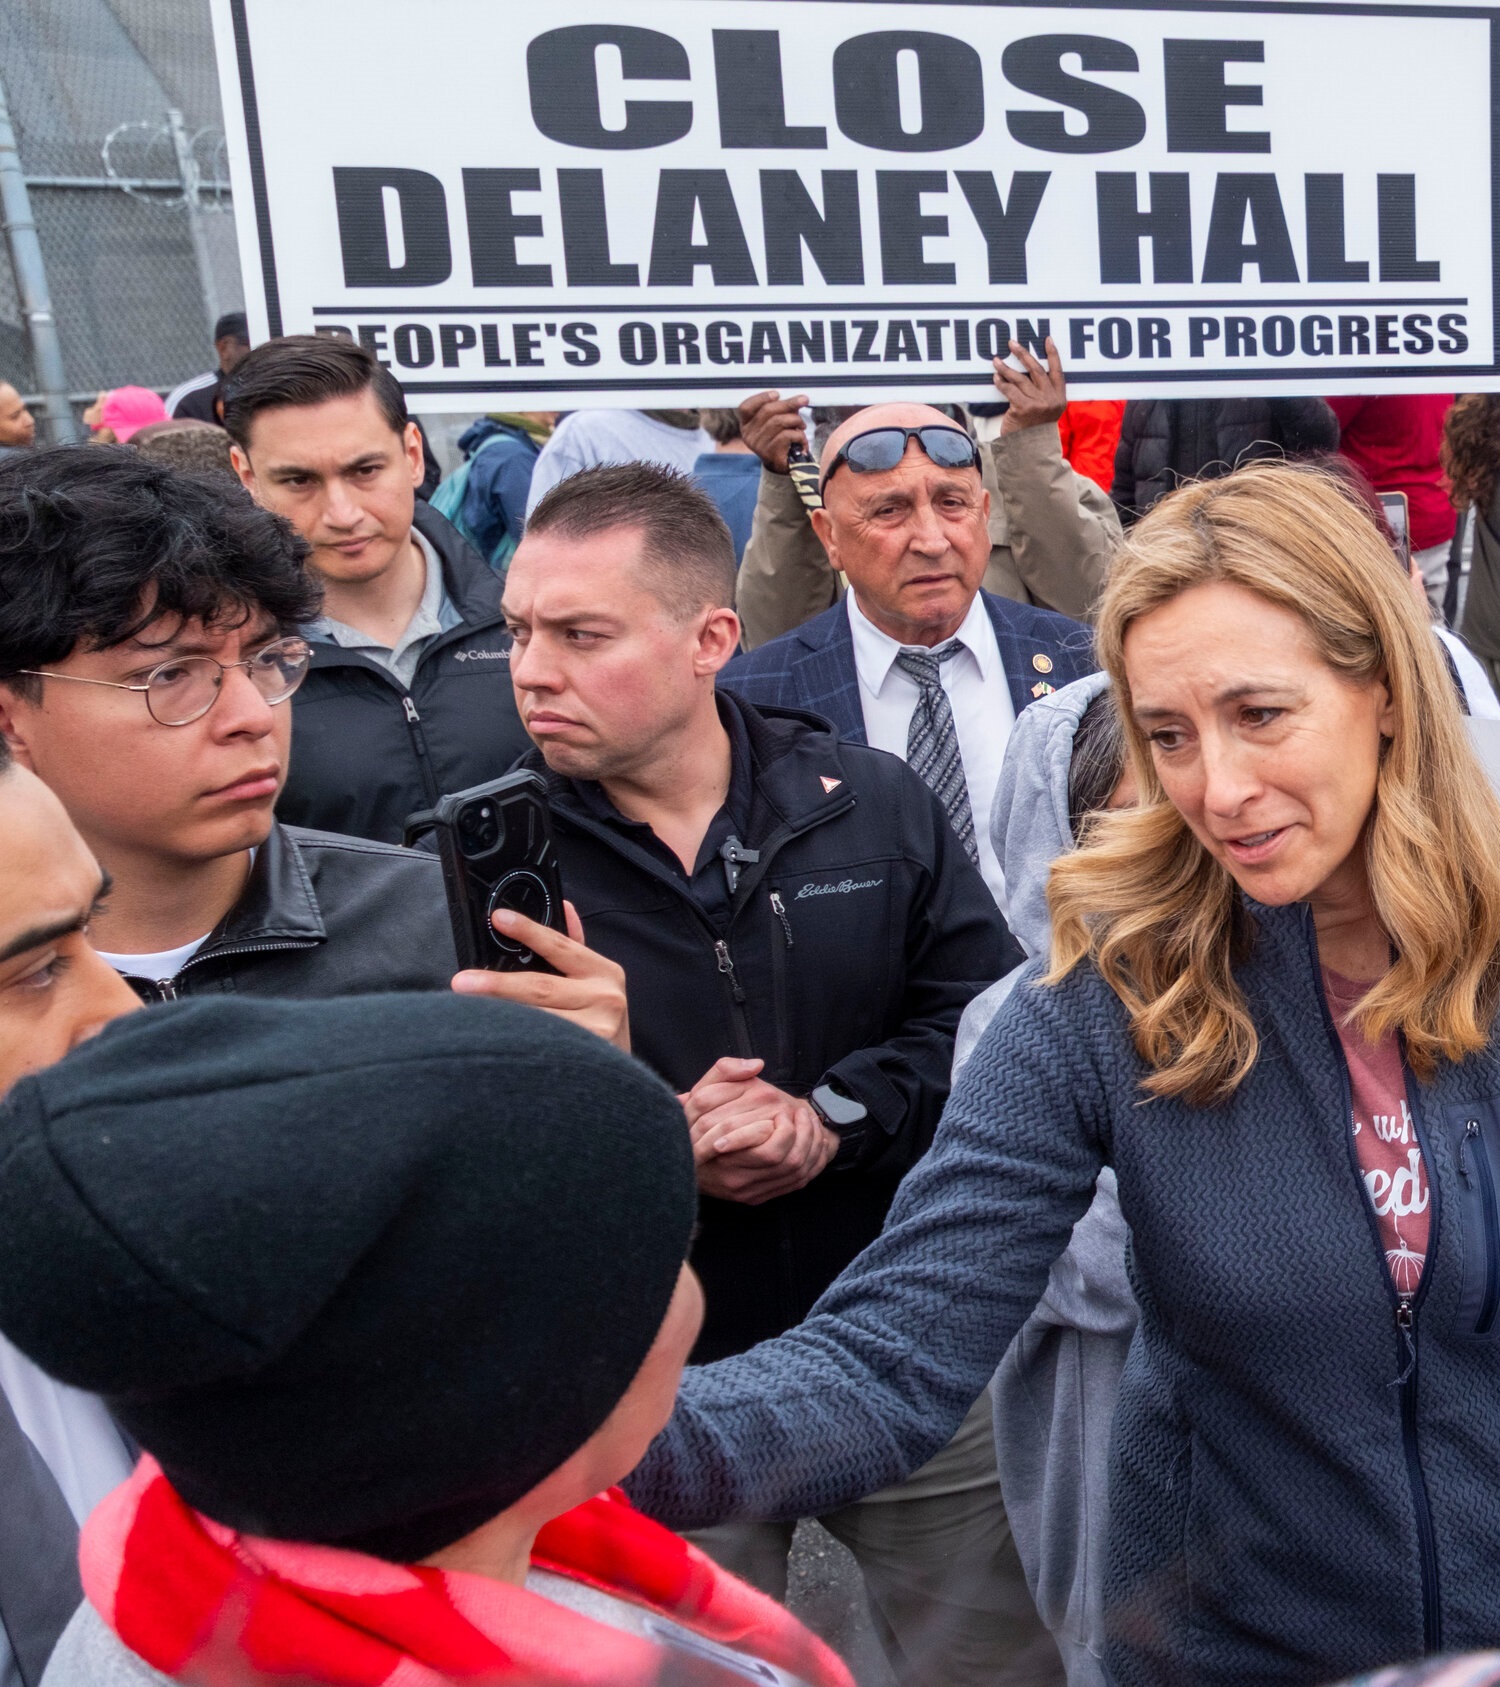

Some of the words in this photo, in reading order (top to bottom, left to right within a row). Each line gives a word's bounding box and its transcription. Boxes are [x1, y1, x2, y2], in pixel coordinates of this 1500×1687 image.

[526, 24, 1271, 154] CLOSE
[332, 166, 1051, 287] DELANEY
[1095, 171, 1440, 284] HALL
[618, 317, 1050, 366] ORGANIZATION
[1069, 316, 1171, 360] FOR
[1188, 312, 1468, 358] PROGRESS
[468, 649, 511, 661] Columb
[794, 883, 837, 900] Eddie
[837, 879, 883, 894] Bauer
[1372, 1099, 1418, 1145] wh
[1362, 1148, 1430, 1217] ed
